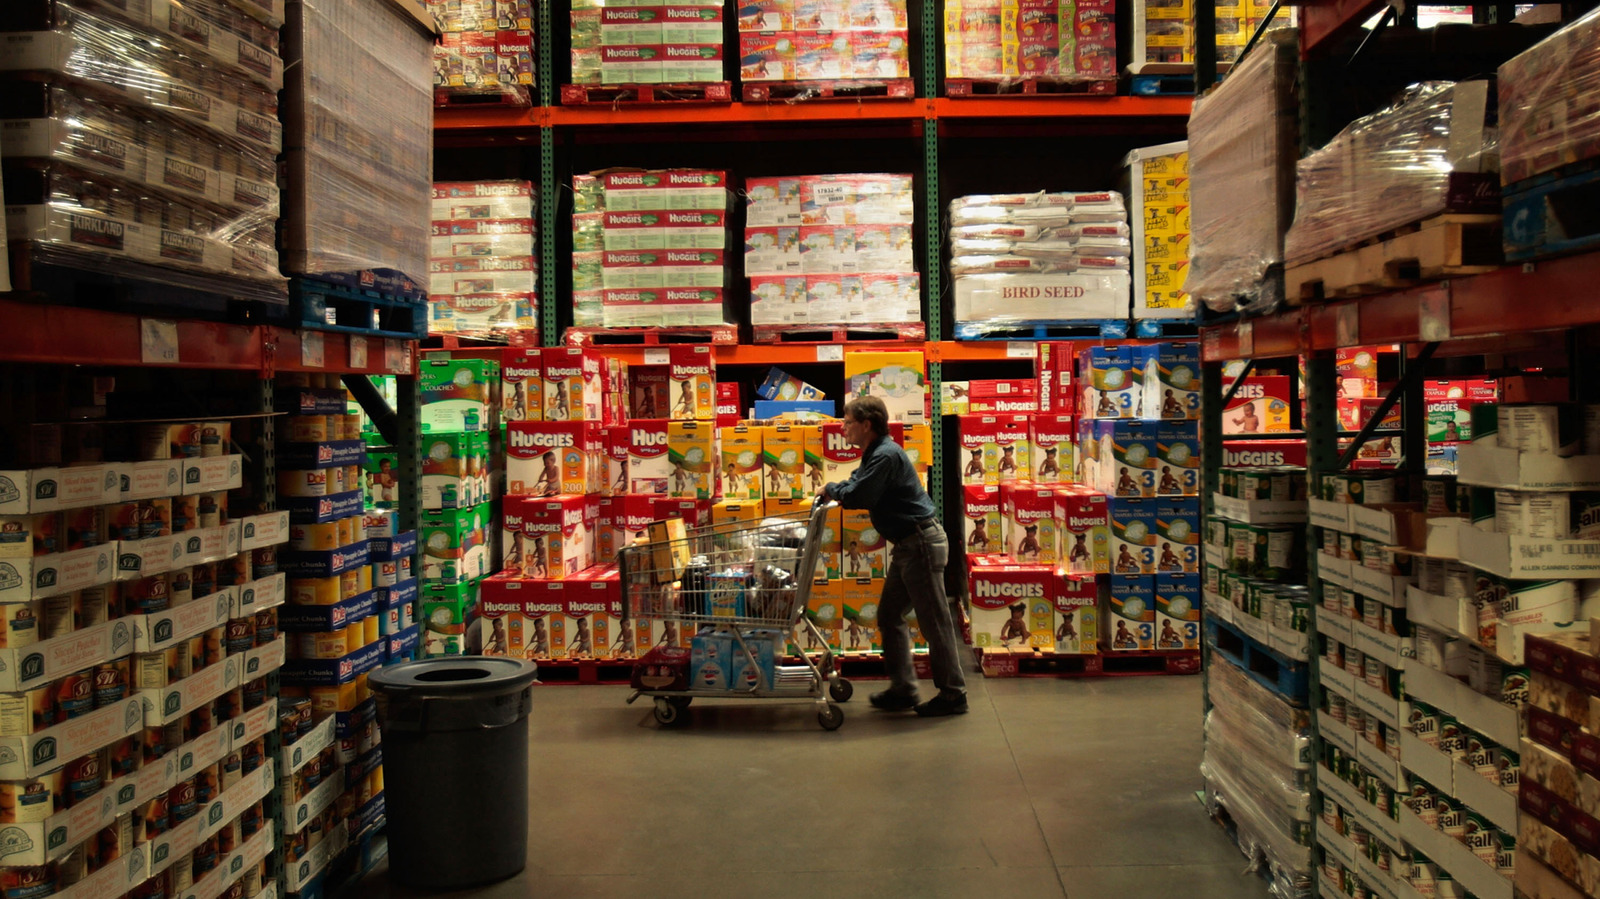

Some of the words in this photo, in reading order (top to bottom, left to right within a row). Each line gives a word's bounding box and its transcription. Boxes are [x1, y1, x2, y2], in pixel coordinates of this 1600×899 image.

[607, 10, 638, 20] HUGGIES
[667, 9, 700, 18] HUGGIES
[465, 46, 495, 54] HUGGIES
[500, 44, 529, 52] HUGGIES
[607, 48, 639, 58] HUGGIES
[667, 47, 700, 56] HUGGIES
[611, 176, 643, 185] HUGGIES
[670, 174, 703, 184] HUGGIES
[475, 184, 519, 196] HUGGIES
[609, 215, 642, 224] HUGGIES
[669, 213, 702, 223] HUGGIES
[74, 214, 123, 236] KIRKLAND
[477, 222, 521, 234] HUGGIES
[164, 231, 204, 249] KIRKLAND
[608, 254, 640, 263] HUGGIES
[668, 252, 700, 262] HUGGIES
[479, 260, 523, 271] HUGGIES
[607, 292, 640, 302] HUGGIES
[667, 291, 699, 300] HUGGIES
[1003, 287, 1040, 298] BIRD
[1044, 286, 1084, 298] SEED
[456, 296, 498, 307] HUGGIES
[506, 367, 539, 377] HUGGIES
[548, 367, 581, 376] HUGGIES
[673, 365, 708, 374] HUGGIES
[425, 384, 454, 392] COUCHES
[1041, 370, 1052, 411] HUGGIES
[1120, 392, 1132, 407] 3
[1189, 392, 1200, 407] 3
[716, 406, 736, 414] GIES
[996, 401, 1034, 411] HUGGIES
[1428, 404, 1458, 412] UGGIES
[468, 408, 479, 423] 5
[510, 430, 573, 447] HUGGIES
[964, 434, 995, 443] HUGGIES
[997, 432, 1027, 440] HUGGIES
[1038, 433, 1070, 442] HUGGIES
[319, 445, 332, 460] Dole
[307, 473, 325, 483] Dole
[1143, 471, 1155, 486] 3
[1184, 470, 1196, 487] 3
[448, 484, 457, 496] 5
[565, 482, 583, 493] 200
[320, 499, 332, 515] Dole
[967, 504, 998, 512] HUGGIES
[1018, 509, 1051, 519] HUGGIES
[365, 516, 388, 525] Dole
[628, 515, 654, 525] HUGG
[1070, 517, 1106, 526] HUGGIES
[525, 522, 561, 532] HUGGIES
[1142, 548, 1154, 563] 3
[1185, 546, 1197, 562] 3
[333, 552, 344, 569] Dole
[976, 580, 1043, 598] HUGGIES
[1057, 596, 1093, 606] HUGGIES
[484, 602, 521, 612] HUGGIES
[525, 602, 563, 612] HUGGIES
[569, 601, 606, 612] HUGGIES
[333, 606, 345, 622] Dole
[1139, 623, 1152, 640] 3
[1185, 623, 1197, 640] 3
[1032, 634, 1050, 645] 224
[340, 658, 352, 676] Dole
